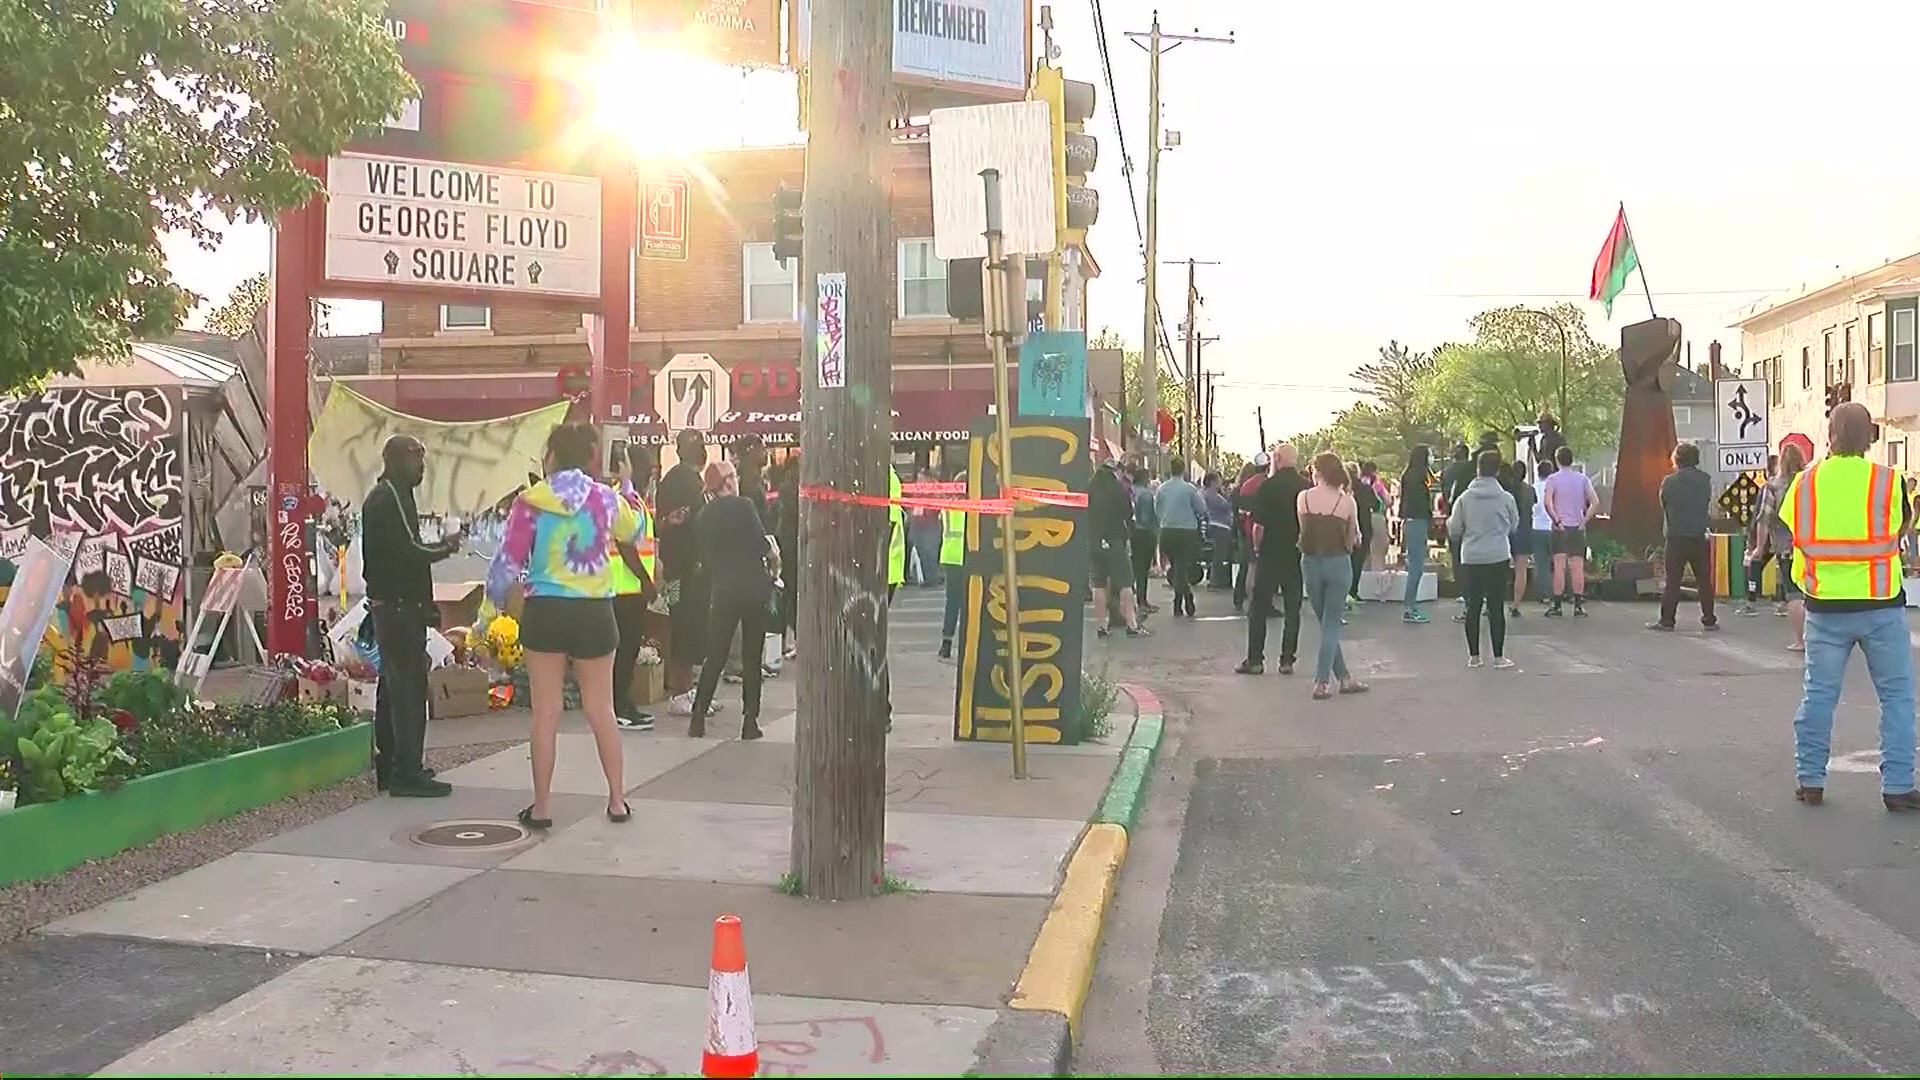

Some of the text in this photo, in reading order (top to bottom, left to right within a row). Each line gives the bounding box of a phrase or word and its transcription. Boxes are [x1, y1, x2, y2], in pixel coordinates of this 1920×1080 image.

[694, 10, 756, 32] MOMMA
[898, 0, 987, 45] REMEMBER
[366, 162, 556, 210] WELCOME TO
[358, 203, 570, 250] GEORGE FLOYD
[412, 248, 516, 286] SQUARE
[746, 410, 801, 424] Prod
[934, 430, 970, 441] FOOD
[762, 433, 795, 444] MILK
[1725, 453, 1761, 466] ONLY
[280, 522, 305, 621] RIP GEORGE
[975, 573, 1071, 744] WASH
